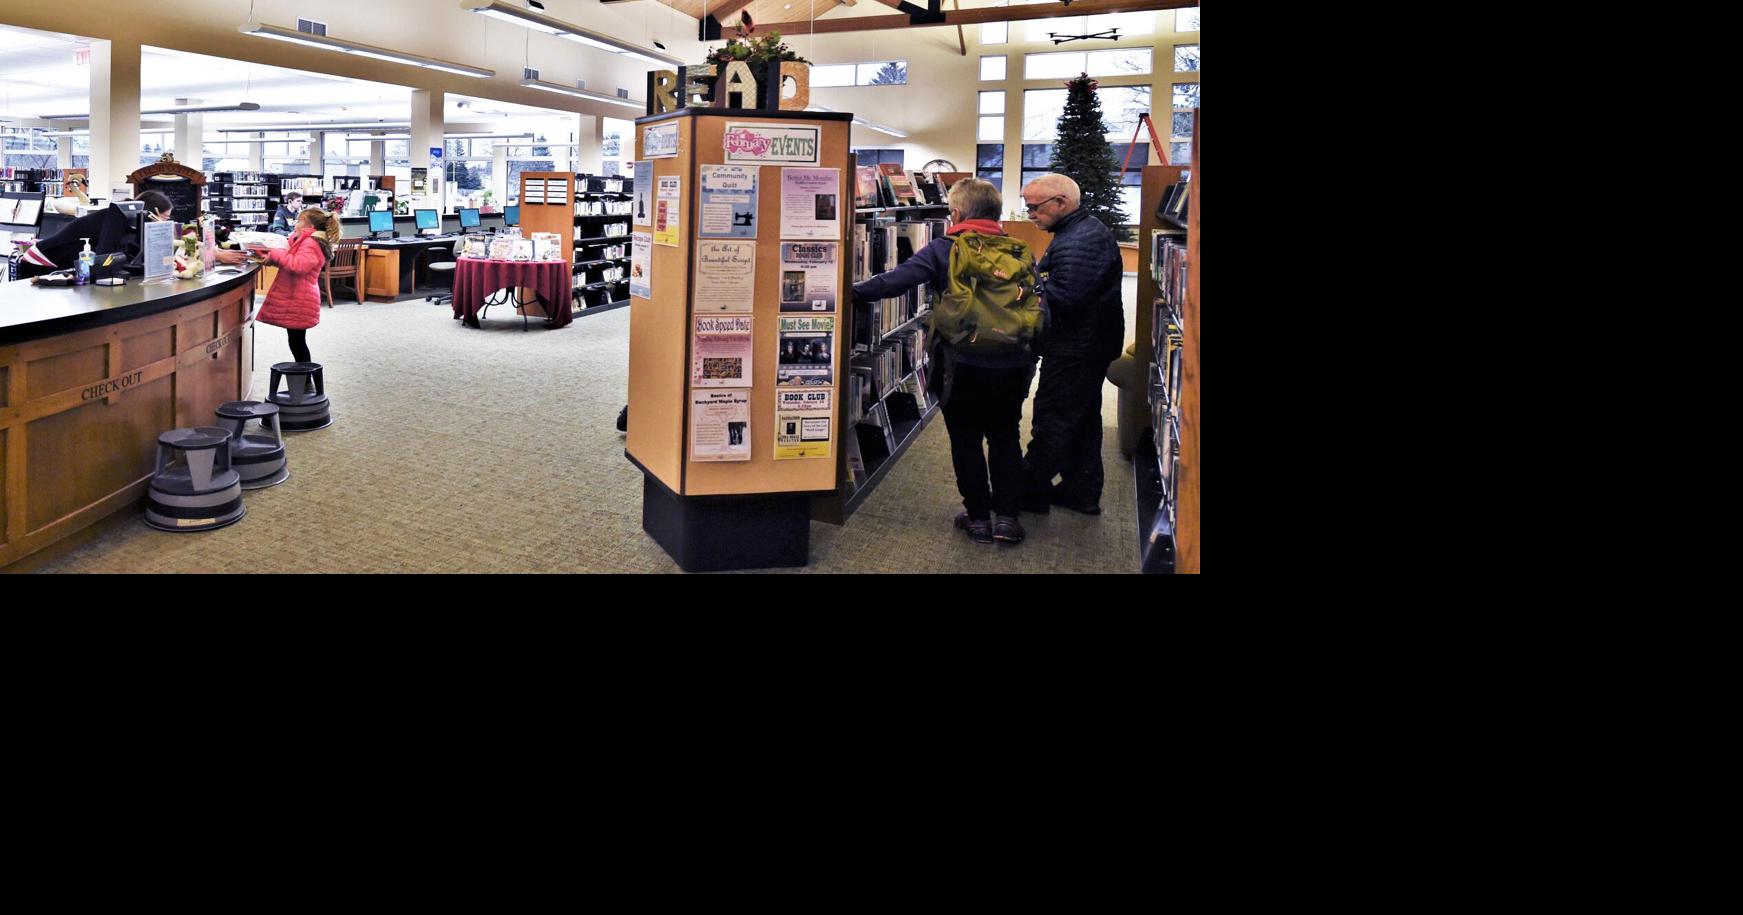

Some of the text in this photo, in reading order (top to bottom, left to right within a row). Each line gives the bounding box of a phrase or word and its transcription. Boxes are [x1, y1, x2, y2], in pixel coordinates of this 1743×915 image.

[647, 61, 810, 115] READ
[724, 131, 814, 157] February EVENTS
[712, 171, 748, 180] Community
[792, 244, 828, 253] Classics
[697, 319, 714, 333] Book
[715, 318, 735, 333] Speed
[780, 318, 797, 330] Must
[798, 318, 810, 330] See
[81, 371, 143, 400] CHECK OUT
[784, 393, 826, 401] BOOK CLUB
